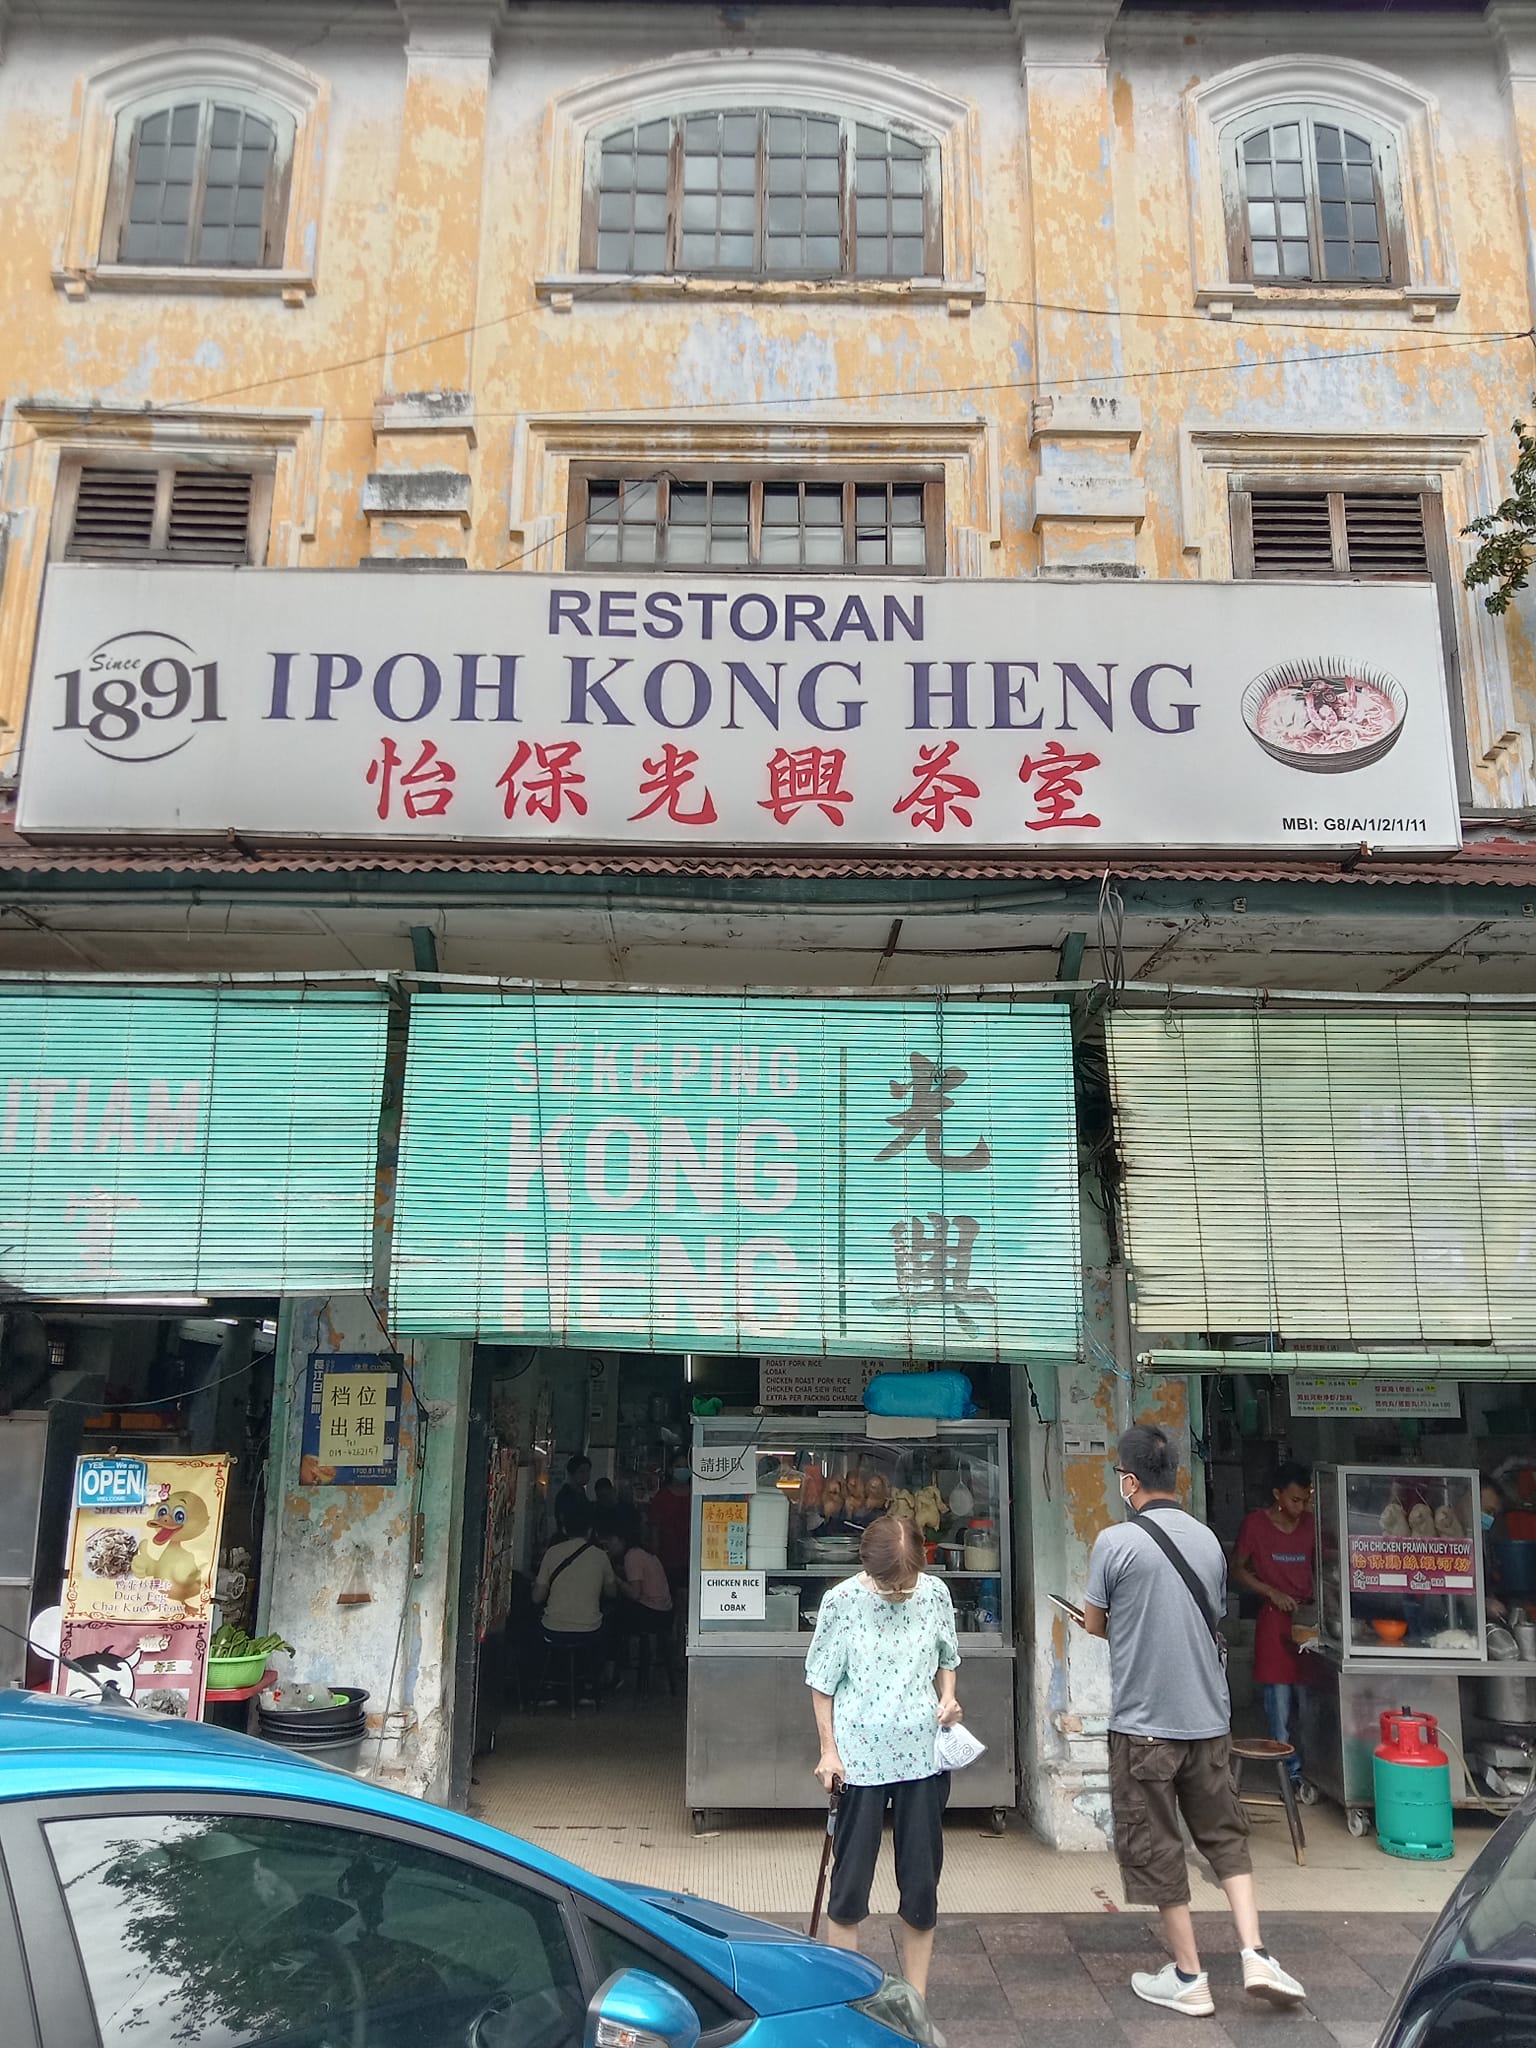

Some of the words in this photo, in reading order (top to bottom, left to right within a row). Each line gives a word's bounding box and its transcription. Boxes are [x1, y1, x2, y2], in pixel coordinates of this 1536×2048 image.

[548, 590, 924, 642] RESTORAN
[89, 653, 141, 672] Since
[52, 660, 228, 741] 1891
[262, 652, 524, 723] IPOH
[561, 656, 869, 732] KONG
[904, 661, 1202, 735] HENG
[365, 737, 1103, 833] 怡保光興茶室
[1282, 817, 1318, 831] MBI:
[1323, 817, 1427, 832] G8/A/1/2/1/11
[512, 1041, 800, 1098] SEKEPING
[504, 1114, 800, 1214] KONG
[503, 1232, 800, 1337] HENG
[766, 1360, 786, 1368] ROAST
[788, 1360, 806, 1368] PORK
[808, 1360, 822, 1368] RICE
[766, 1377, 793, 1385] CHICKEN
[795, 1377, 815, 1385] ROAST
[817, 1377, 835, 1385] PORK
[331, 1385, 377, 1406] 档位
[766, 1394, 787, 1402] EXTRA
[789, 1394, 802, 1402] PER
[804, 1394, 831, 1402] PACKING
[832, 1394, 858, 1402] CHARGE
[330, 1417, 375, 1437] 出租
[83, 1469, 144, 1496] OPEN
[1352, 1540, 1369, 1551] IPOH
[1370, 1541, 1400, 1553] CHICKEN
[1402, 1542, 1428, 1553] PRAWN
[1429, 1542, 1448, 1554] KUEY
[1449, 1543, 1470, 1555] TEOW
[706, 1579, 741, 1587] CHICKEN
[743, 1579, 760, 1587] RICE
[114, 1591, 141, 1601] Duck
[92, 1601, 118, 1611] Char
[720, 1604, 746, 1612] LOBAK
